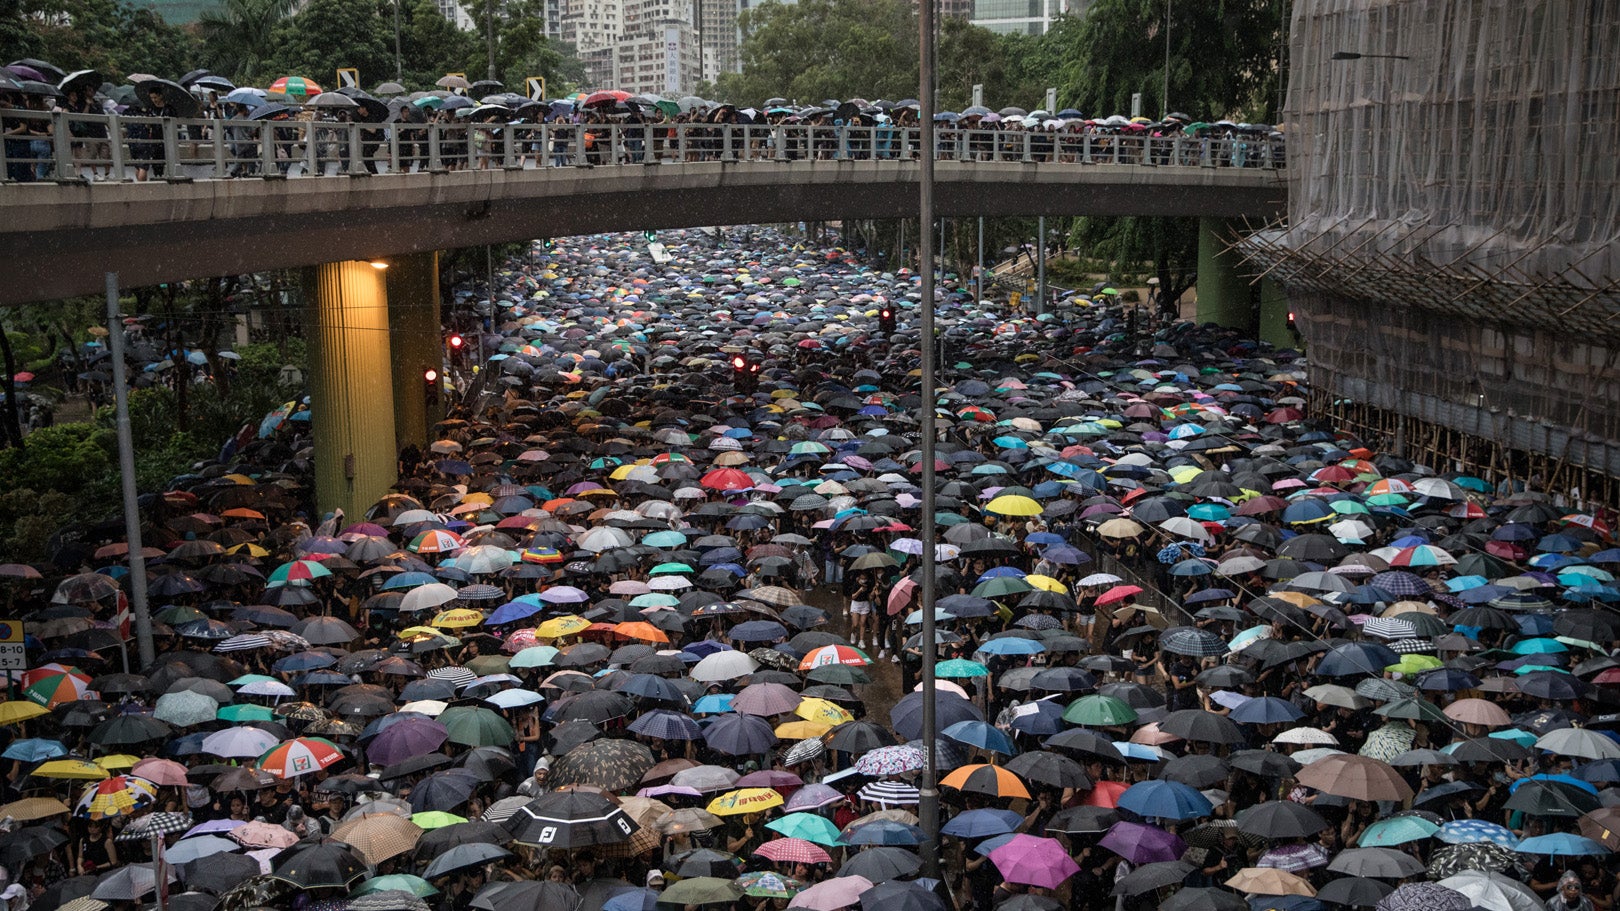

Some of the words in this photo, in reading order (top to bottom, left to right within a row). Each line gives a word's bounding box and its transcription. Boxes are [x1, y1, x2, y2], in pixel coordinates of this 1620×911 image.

[0, 645, 23, 654] 8-10
[1, 658, 21, 666] 5-7
[538, 826, 557, 843] FJ
